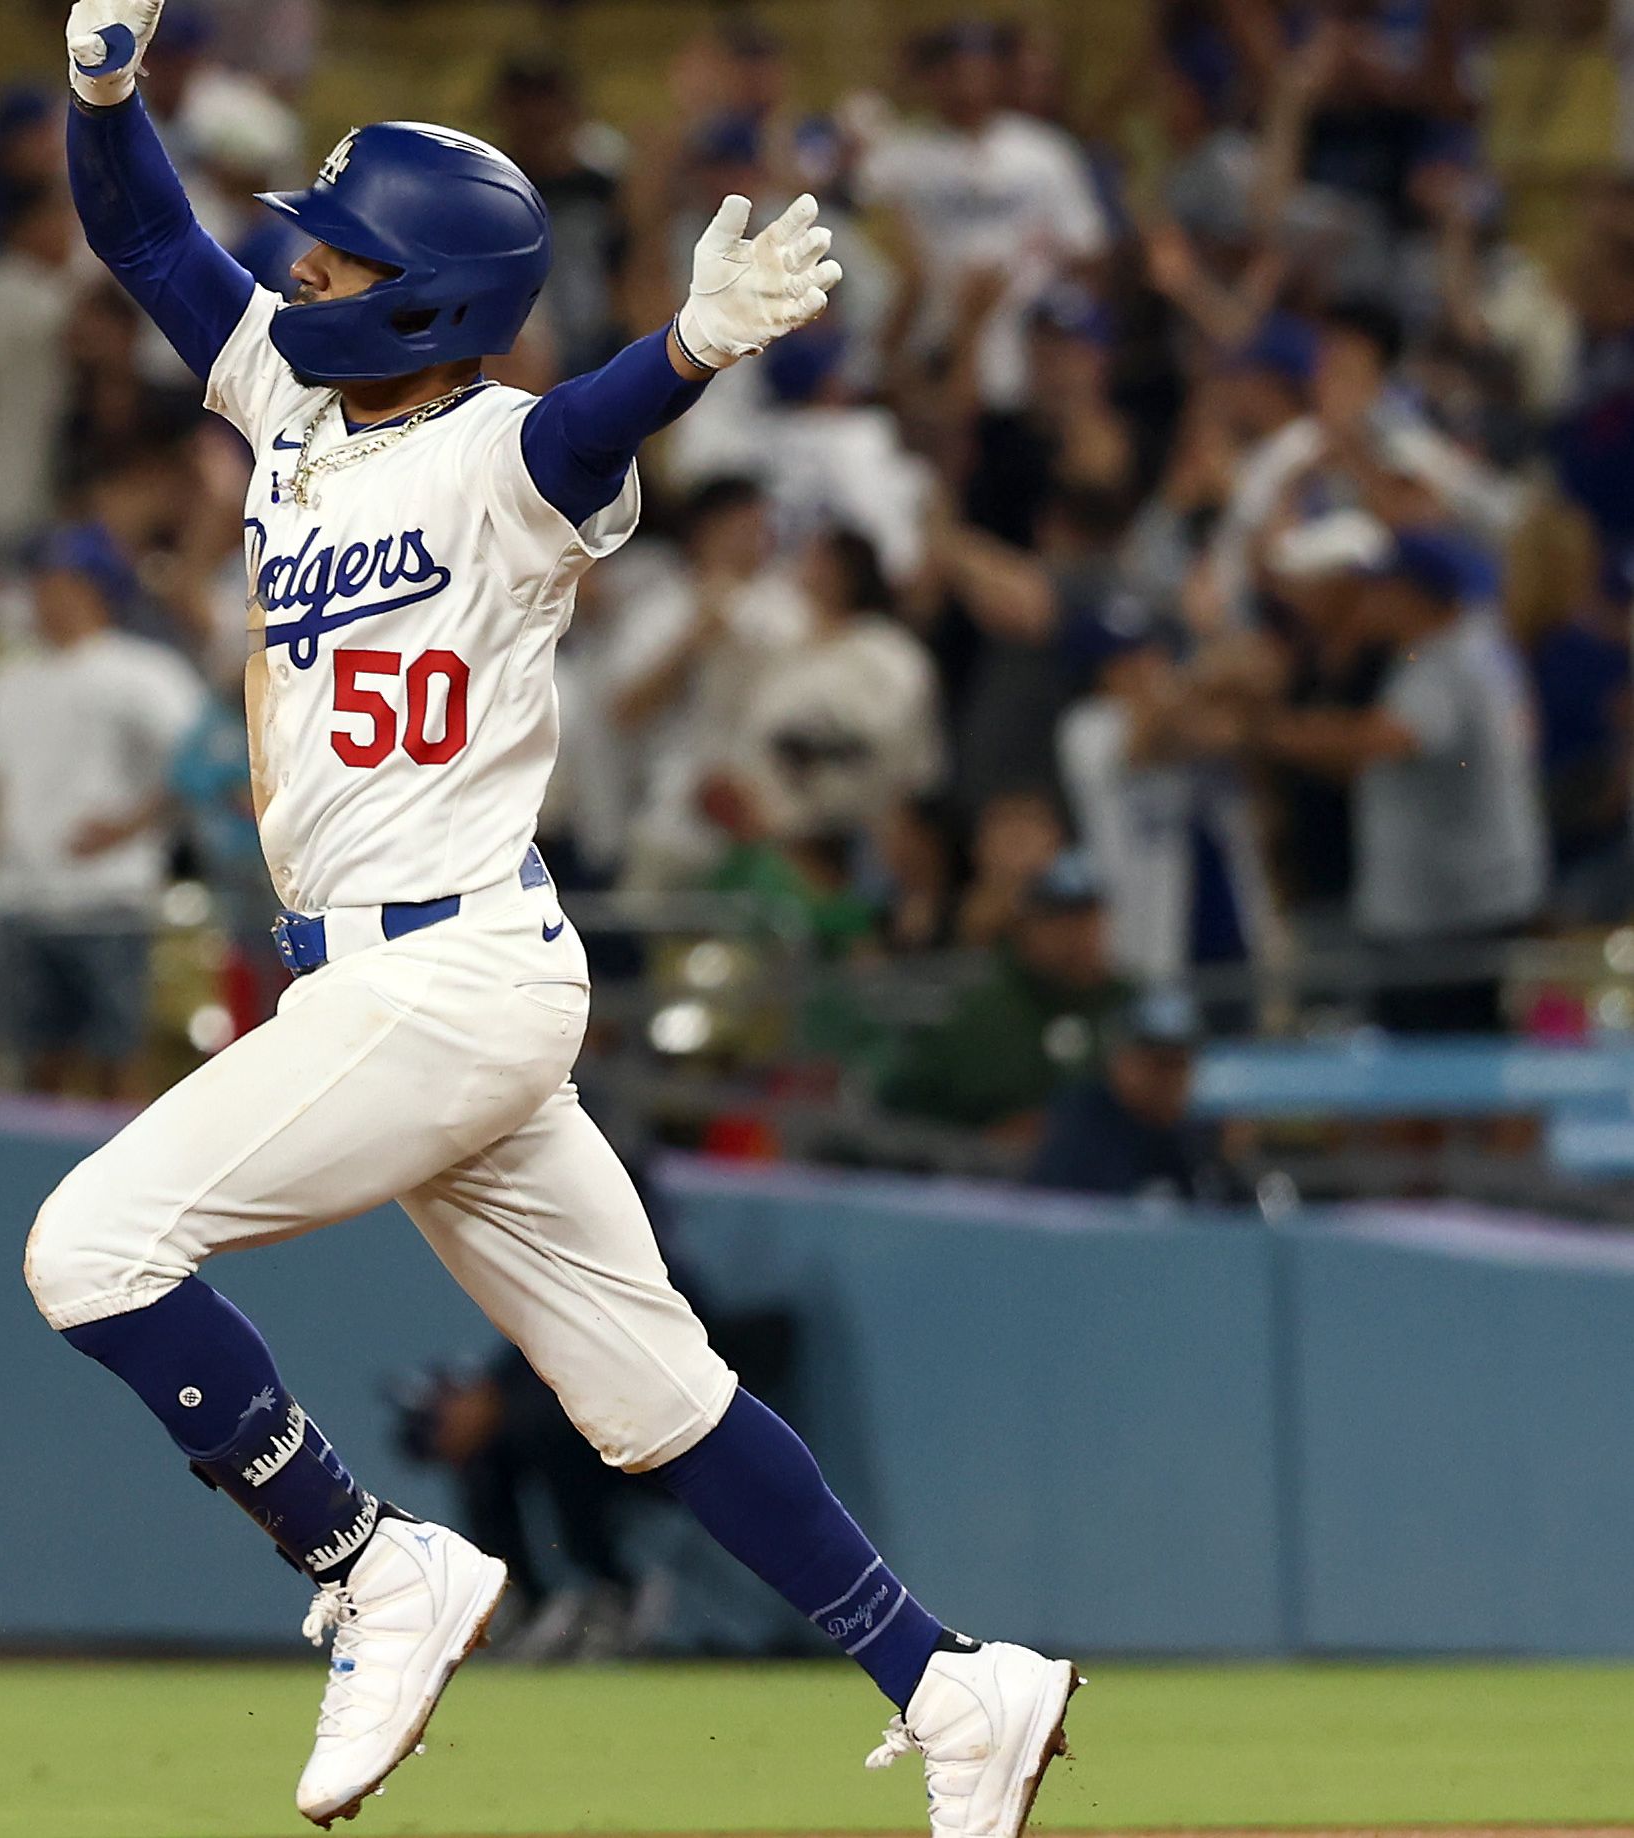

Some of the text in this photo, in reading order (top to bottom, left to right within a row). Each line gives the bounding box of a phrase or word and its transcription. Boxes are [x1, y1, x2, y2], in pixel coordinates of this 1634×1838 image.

[318, 126, 361, 184] LA
[331, 649, 470, 769] 50
[827, 1583, 889, 1640] Dodgers
